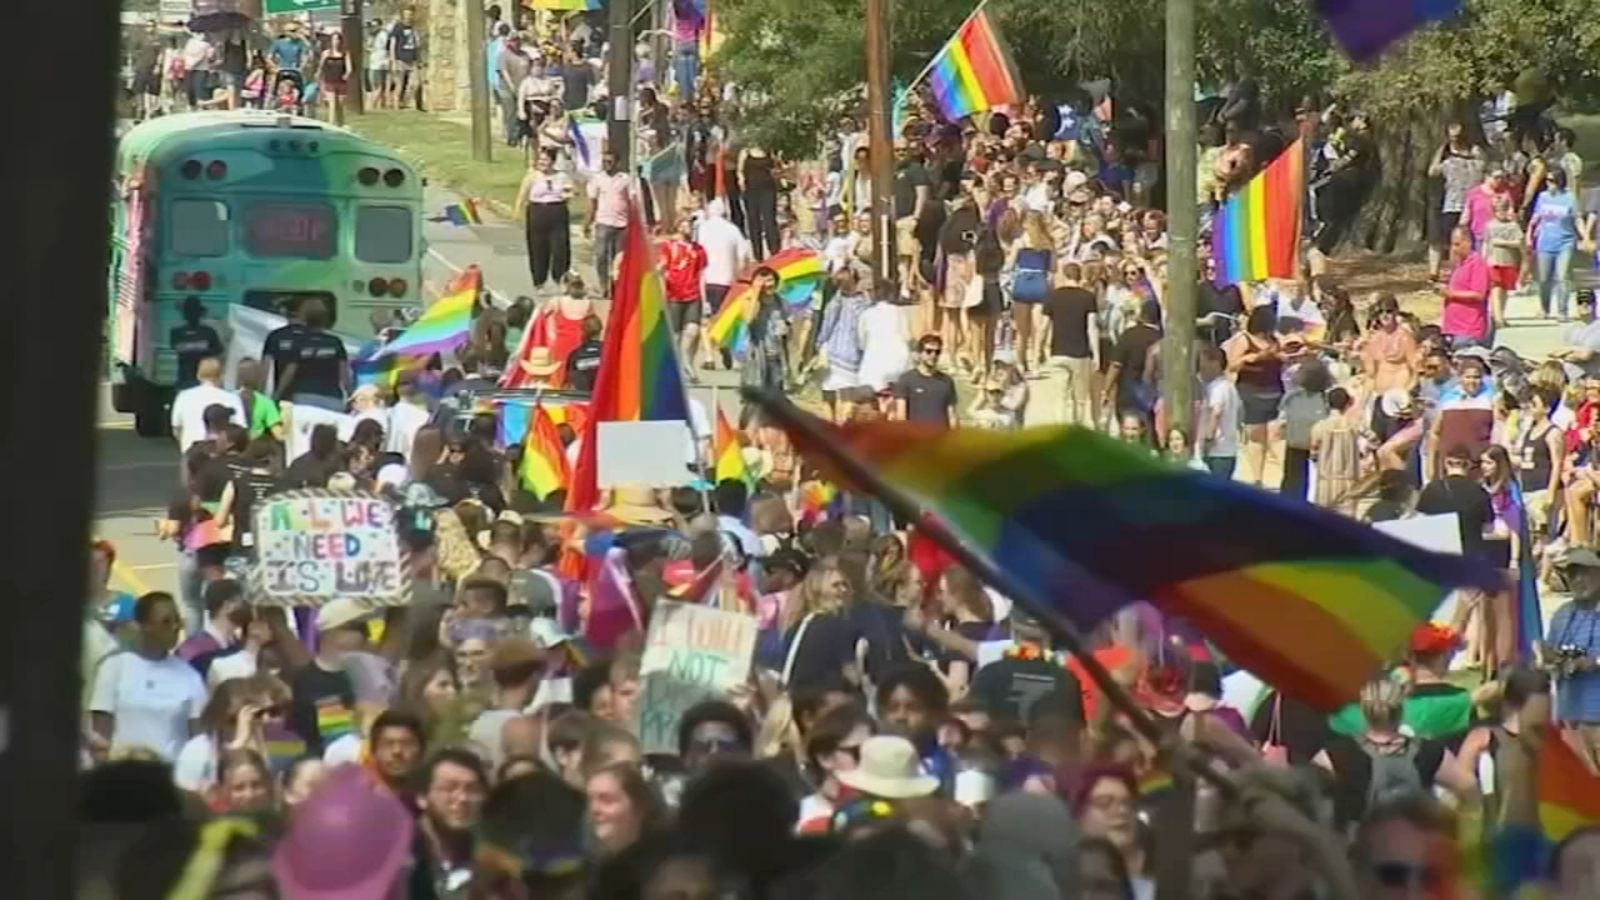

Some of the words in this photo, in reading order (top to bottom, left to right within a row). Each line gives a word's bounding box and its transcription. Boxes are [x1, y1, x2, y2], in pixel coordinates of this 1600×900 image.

[340, 499, 383, 528] WE
[293, 533, 361, 560] NEED
[266, 561, 320, 592] IS
[667, 650, 730, 685] NOT
